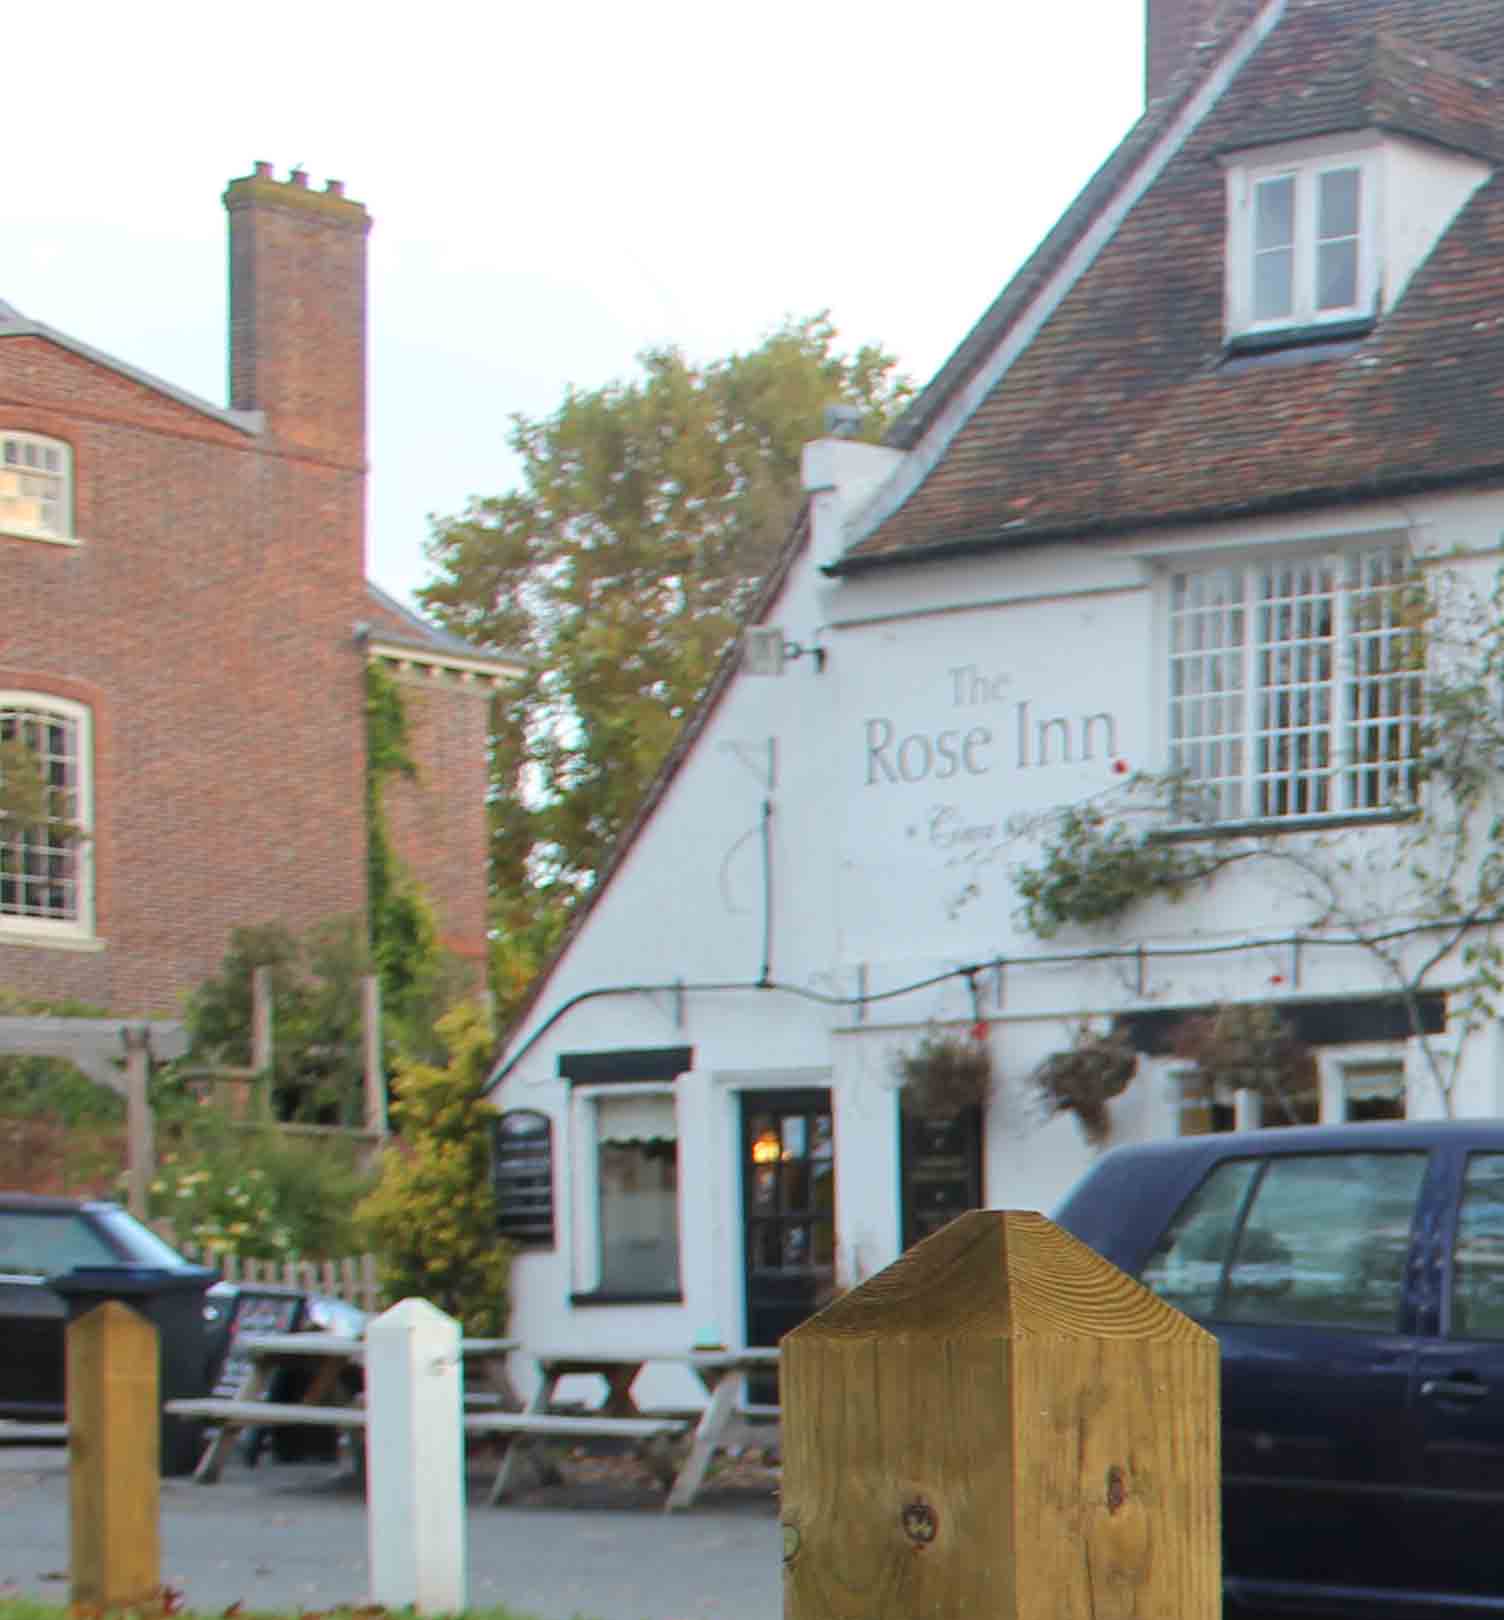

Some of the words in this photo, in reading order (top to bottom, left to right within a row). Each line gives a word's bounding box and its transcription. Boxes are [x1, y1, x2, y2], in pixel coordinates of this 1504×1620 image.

[947, 663, 1012, 711] The
[864, 717, 993, 786] Rose
[1016, 699, 1116, 768] Inn
